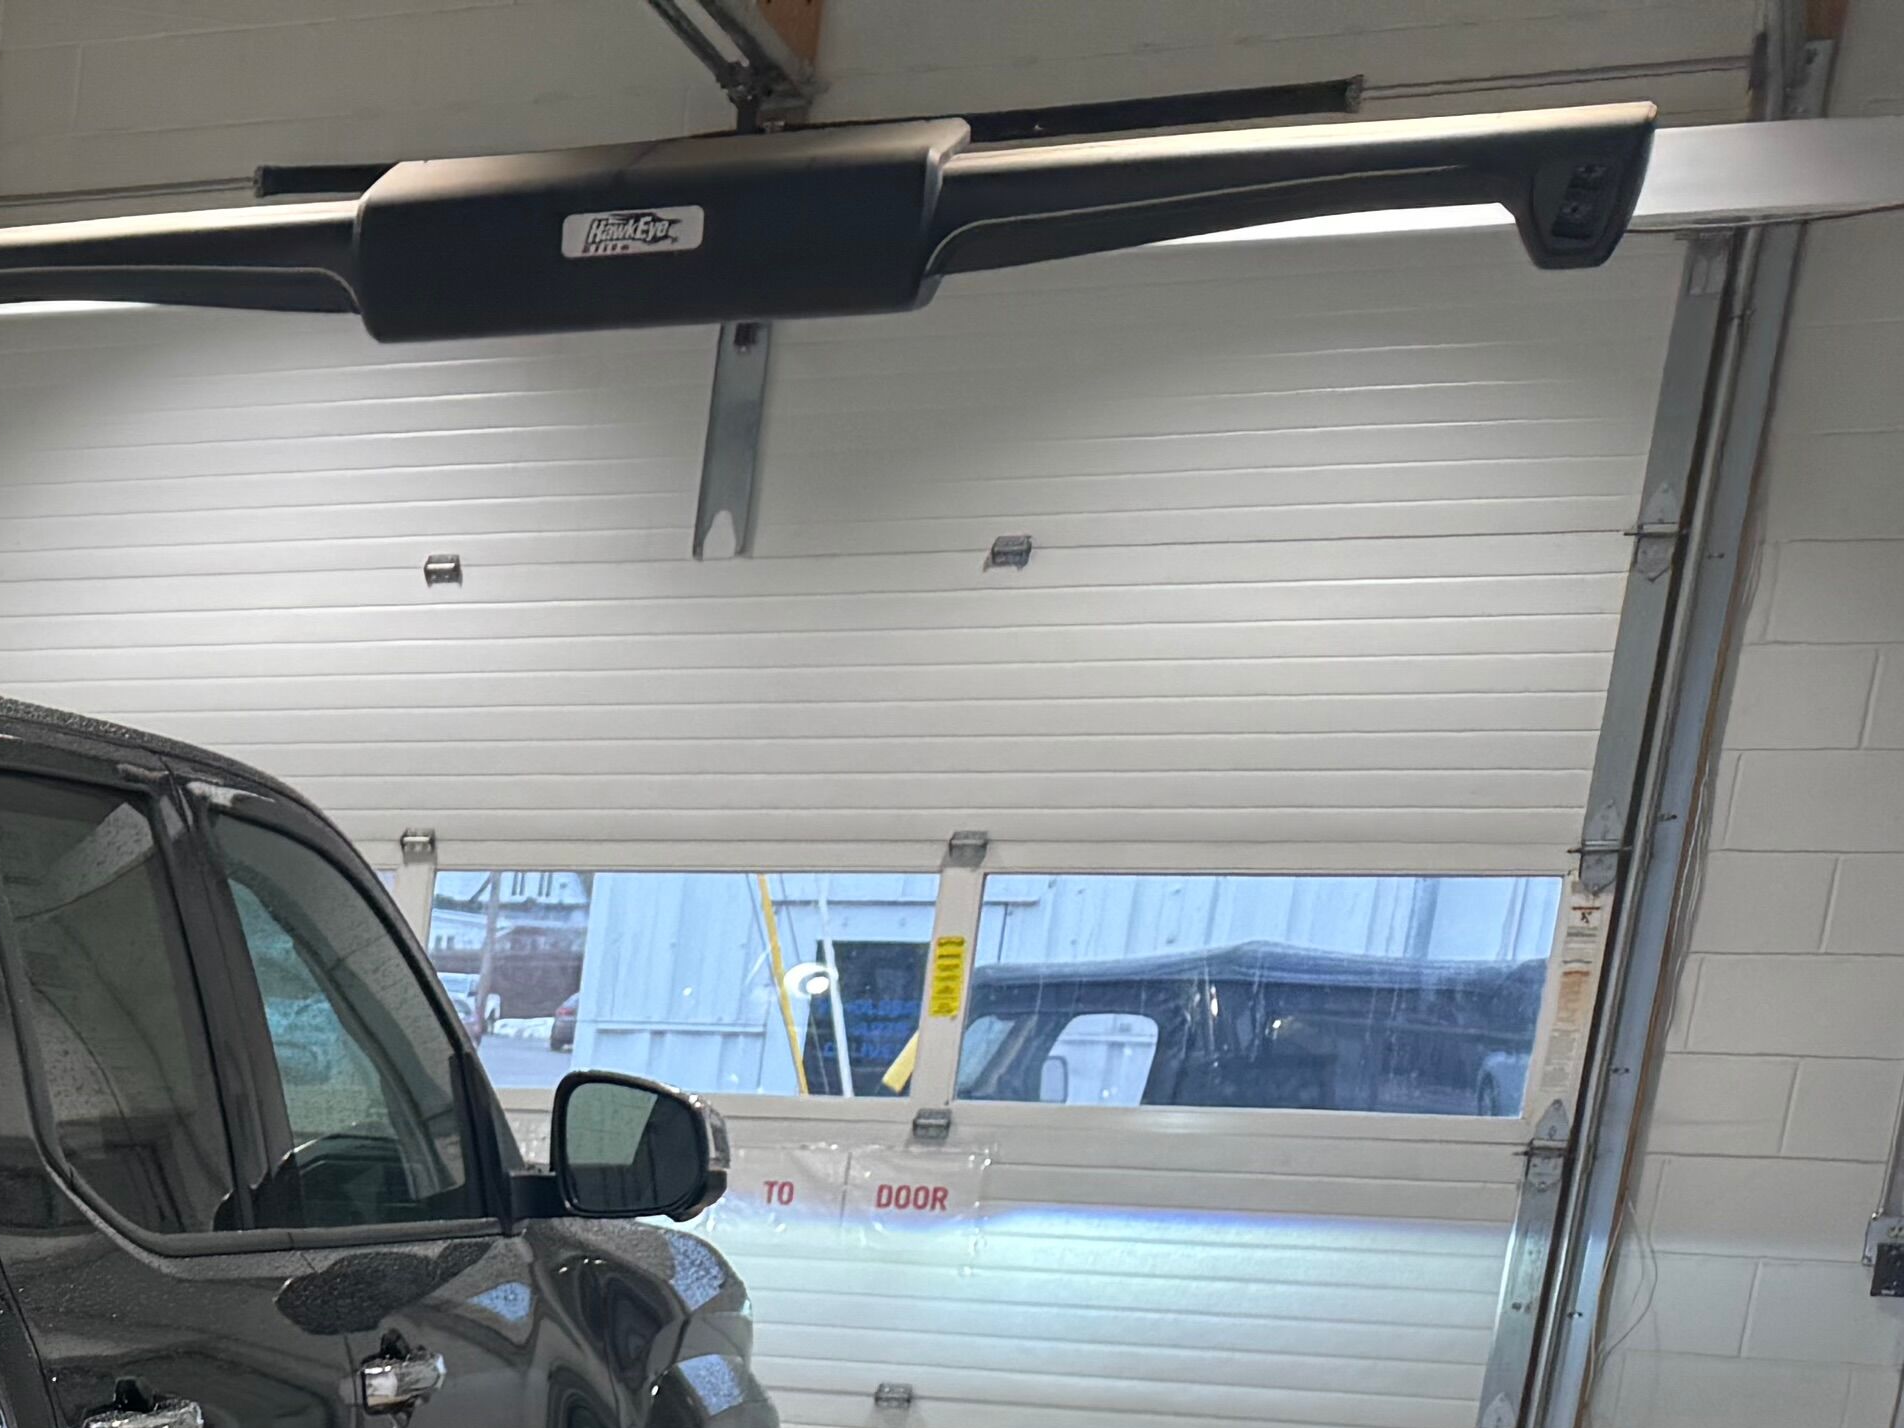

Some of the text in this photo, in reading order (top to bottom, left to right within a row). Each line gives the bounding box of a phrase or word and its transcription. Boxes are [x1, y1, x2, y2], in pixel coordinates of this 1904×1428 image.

[586, 215, 671, 246] HawkEye
[764, 1180, 949, 1212] TO DOOR
